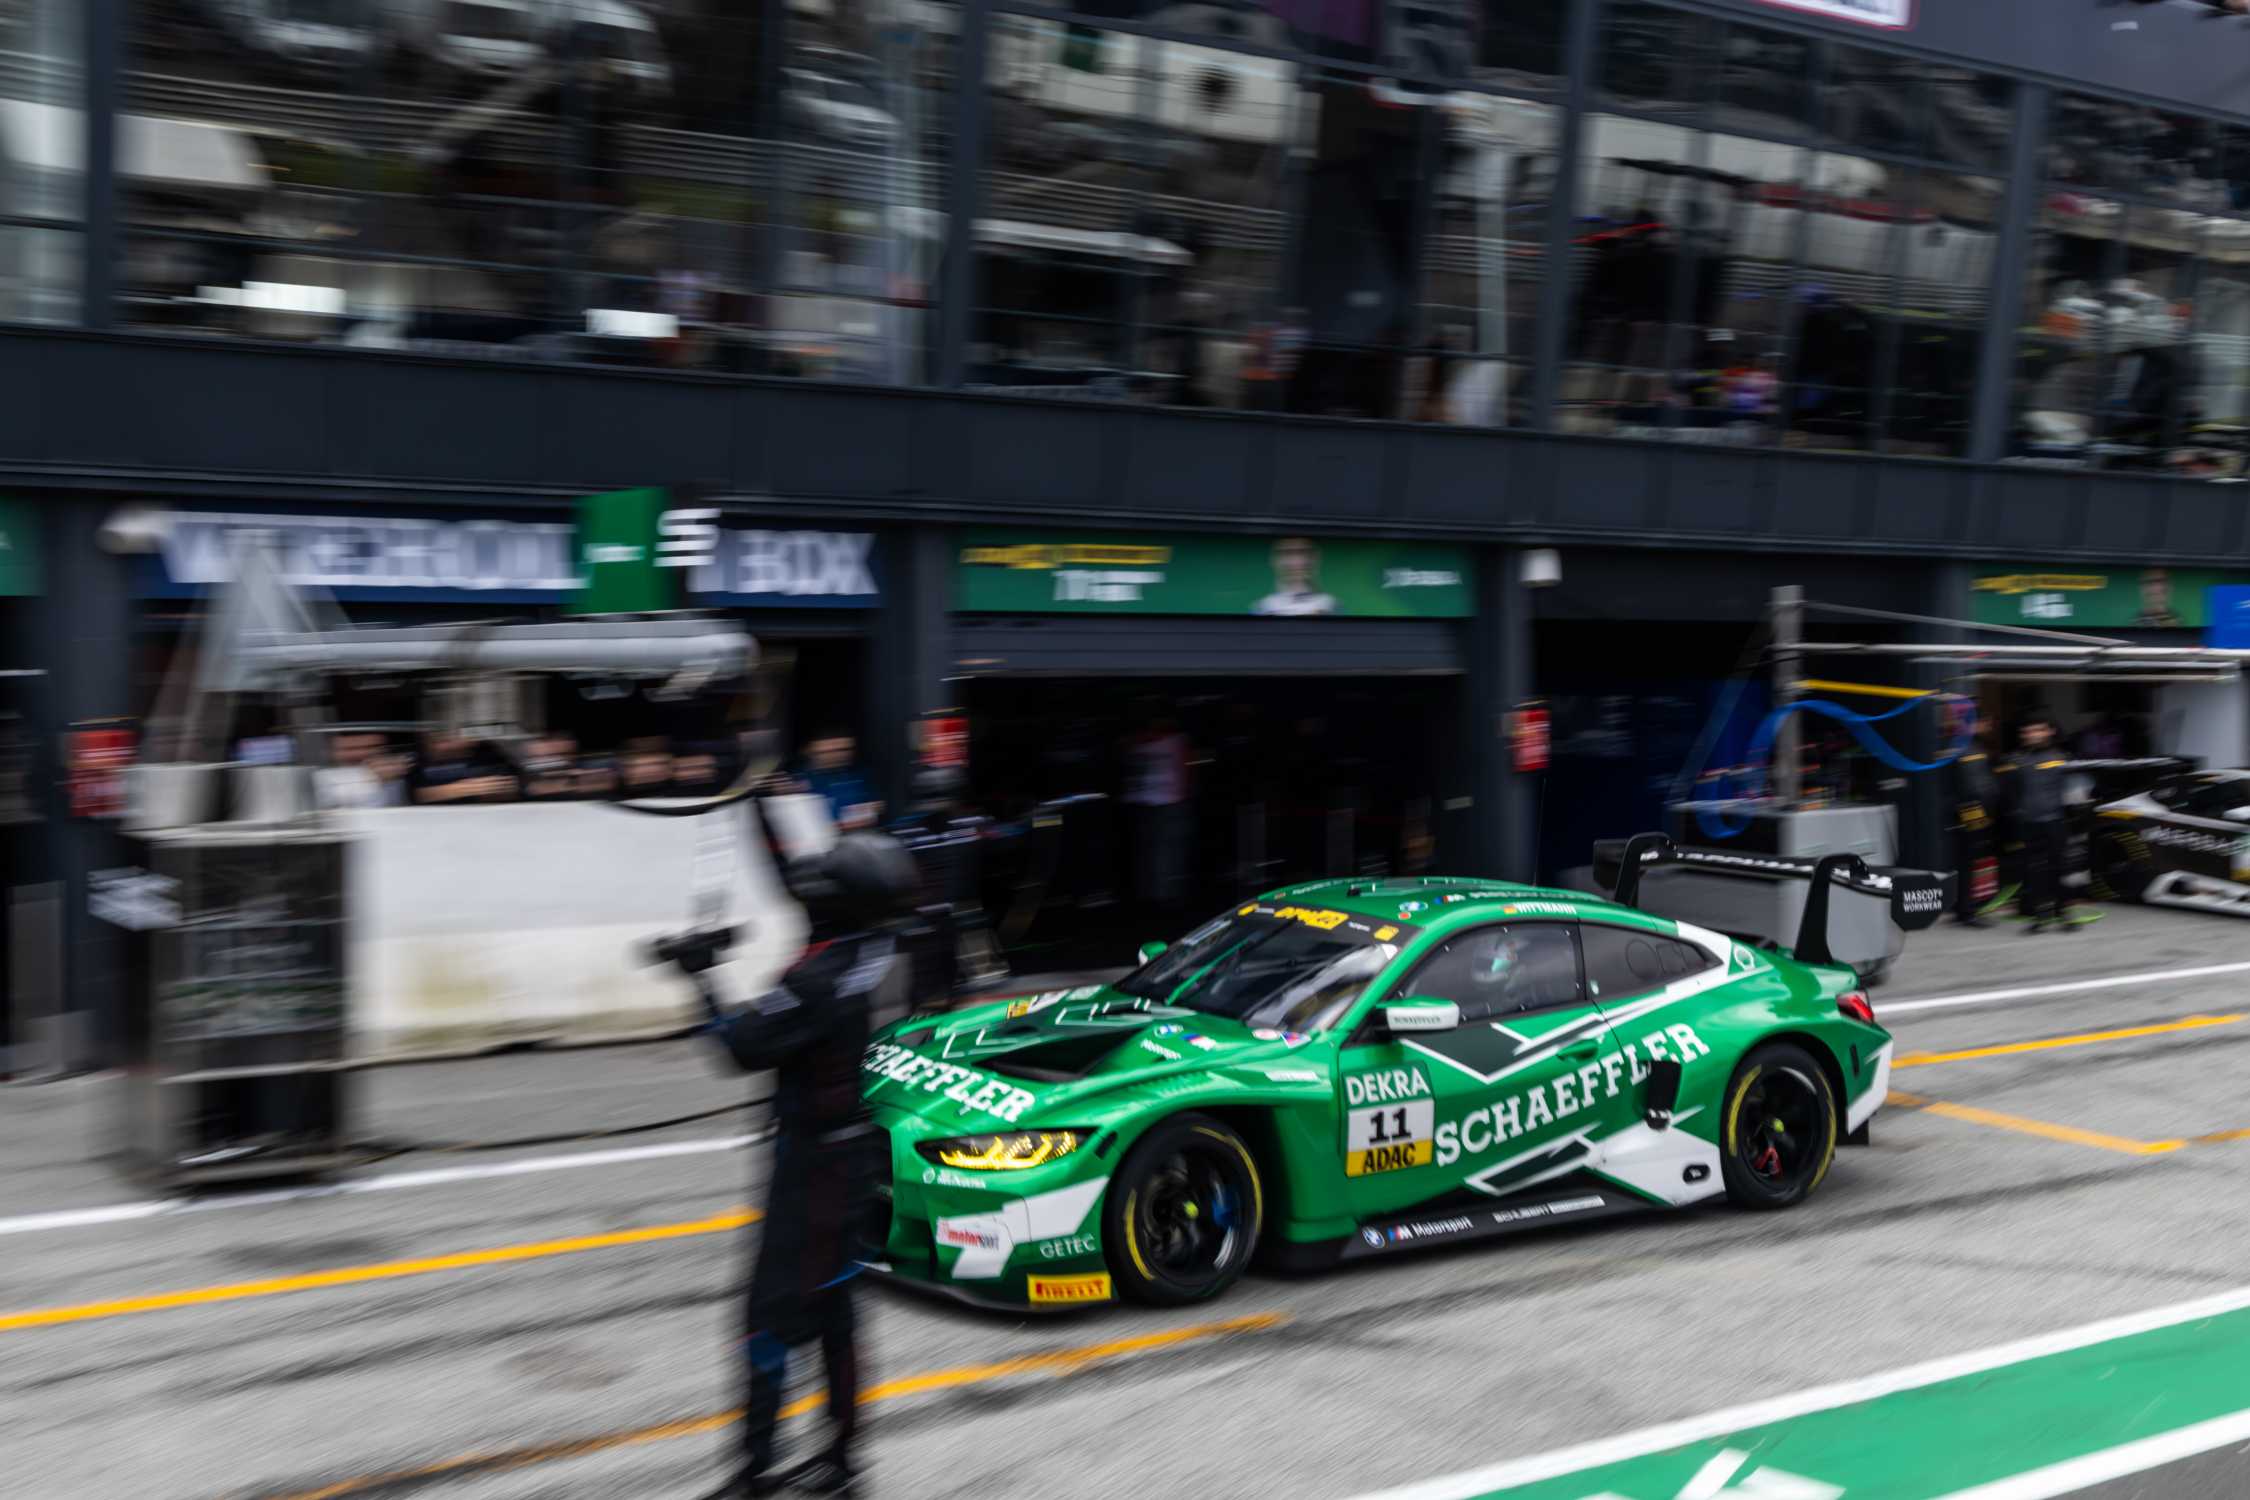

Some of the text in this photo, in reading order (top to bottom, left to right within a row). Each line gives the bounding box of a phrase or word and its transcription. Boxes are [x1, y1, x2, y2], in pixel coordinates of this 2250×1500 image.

[1345, 1066, 1431, 1105] DEKRA
[1435, 1023, 1712, 1167] SCHAEFFLER
[1369, 1107, 1412, 1144] 11
[1364, 1144, 1417, 1174] ADAC
[1412, 1216, 1474, 1238] Motorsport
[1039, 1233, 1097, 1258] GETEC
[1035, 1279, 1105, 1299] PIRELLI
